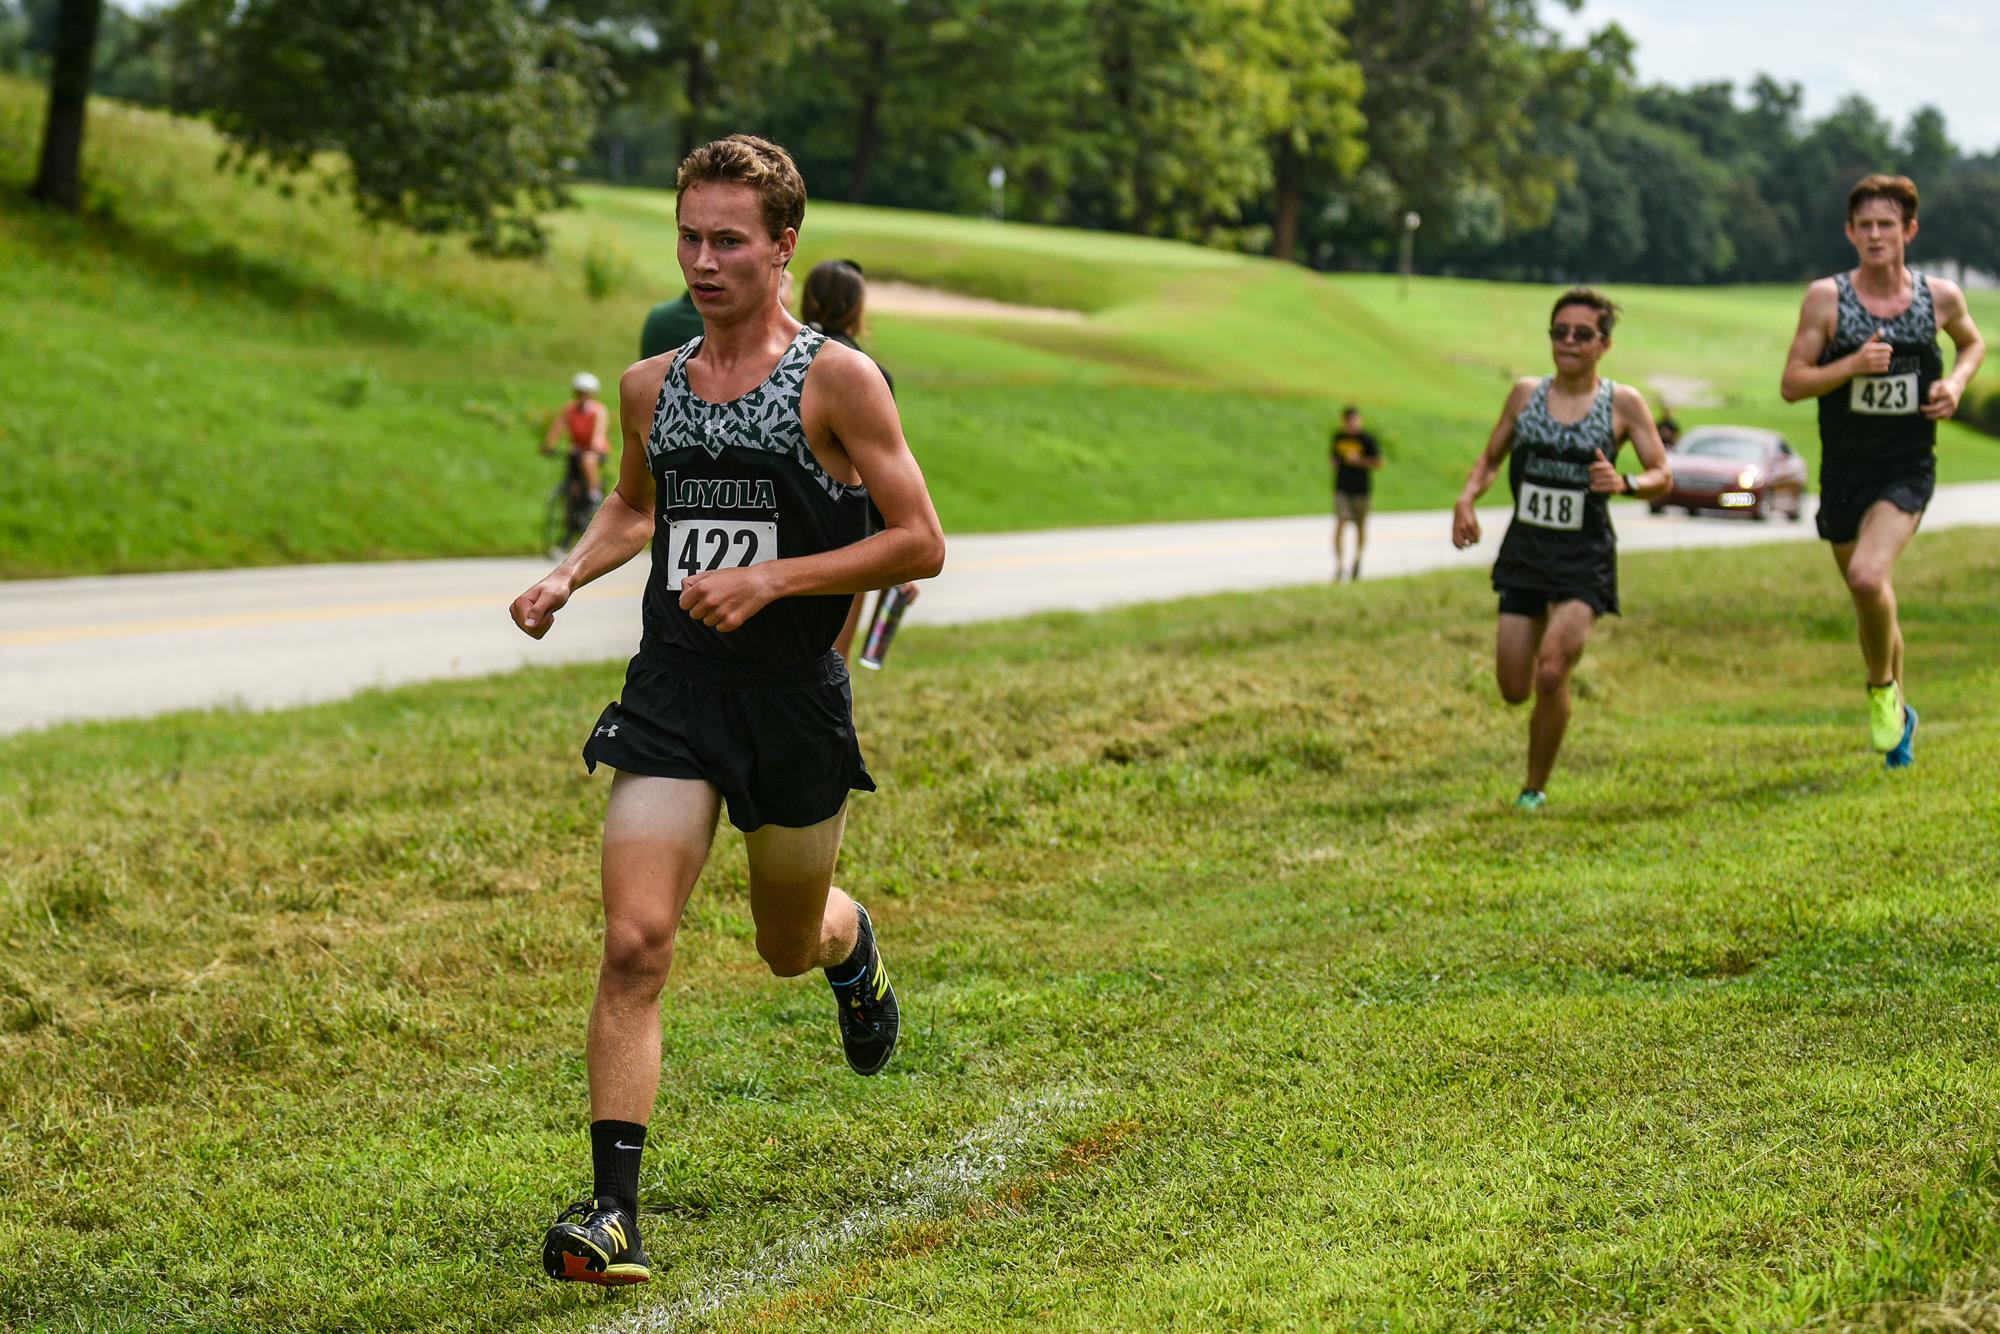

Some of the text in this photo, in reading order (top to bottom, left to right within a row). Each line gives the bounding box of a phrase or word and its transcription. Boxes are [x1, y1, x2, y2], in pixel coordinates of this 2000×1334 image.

[1861, 381, 1908, 408] 423
[665, 470, 776, 509] LOYOLA
[1528, 491, 1573, 524] 418
[678, 528, 759, 577] 422
